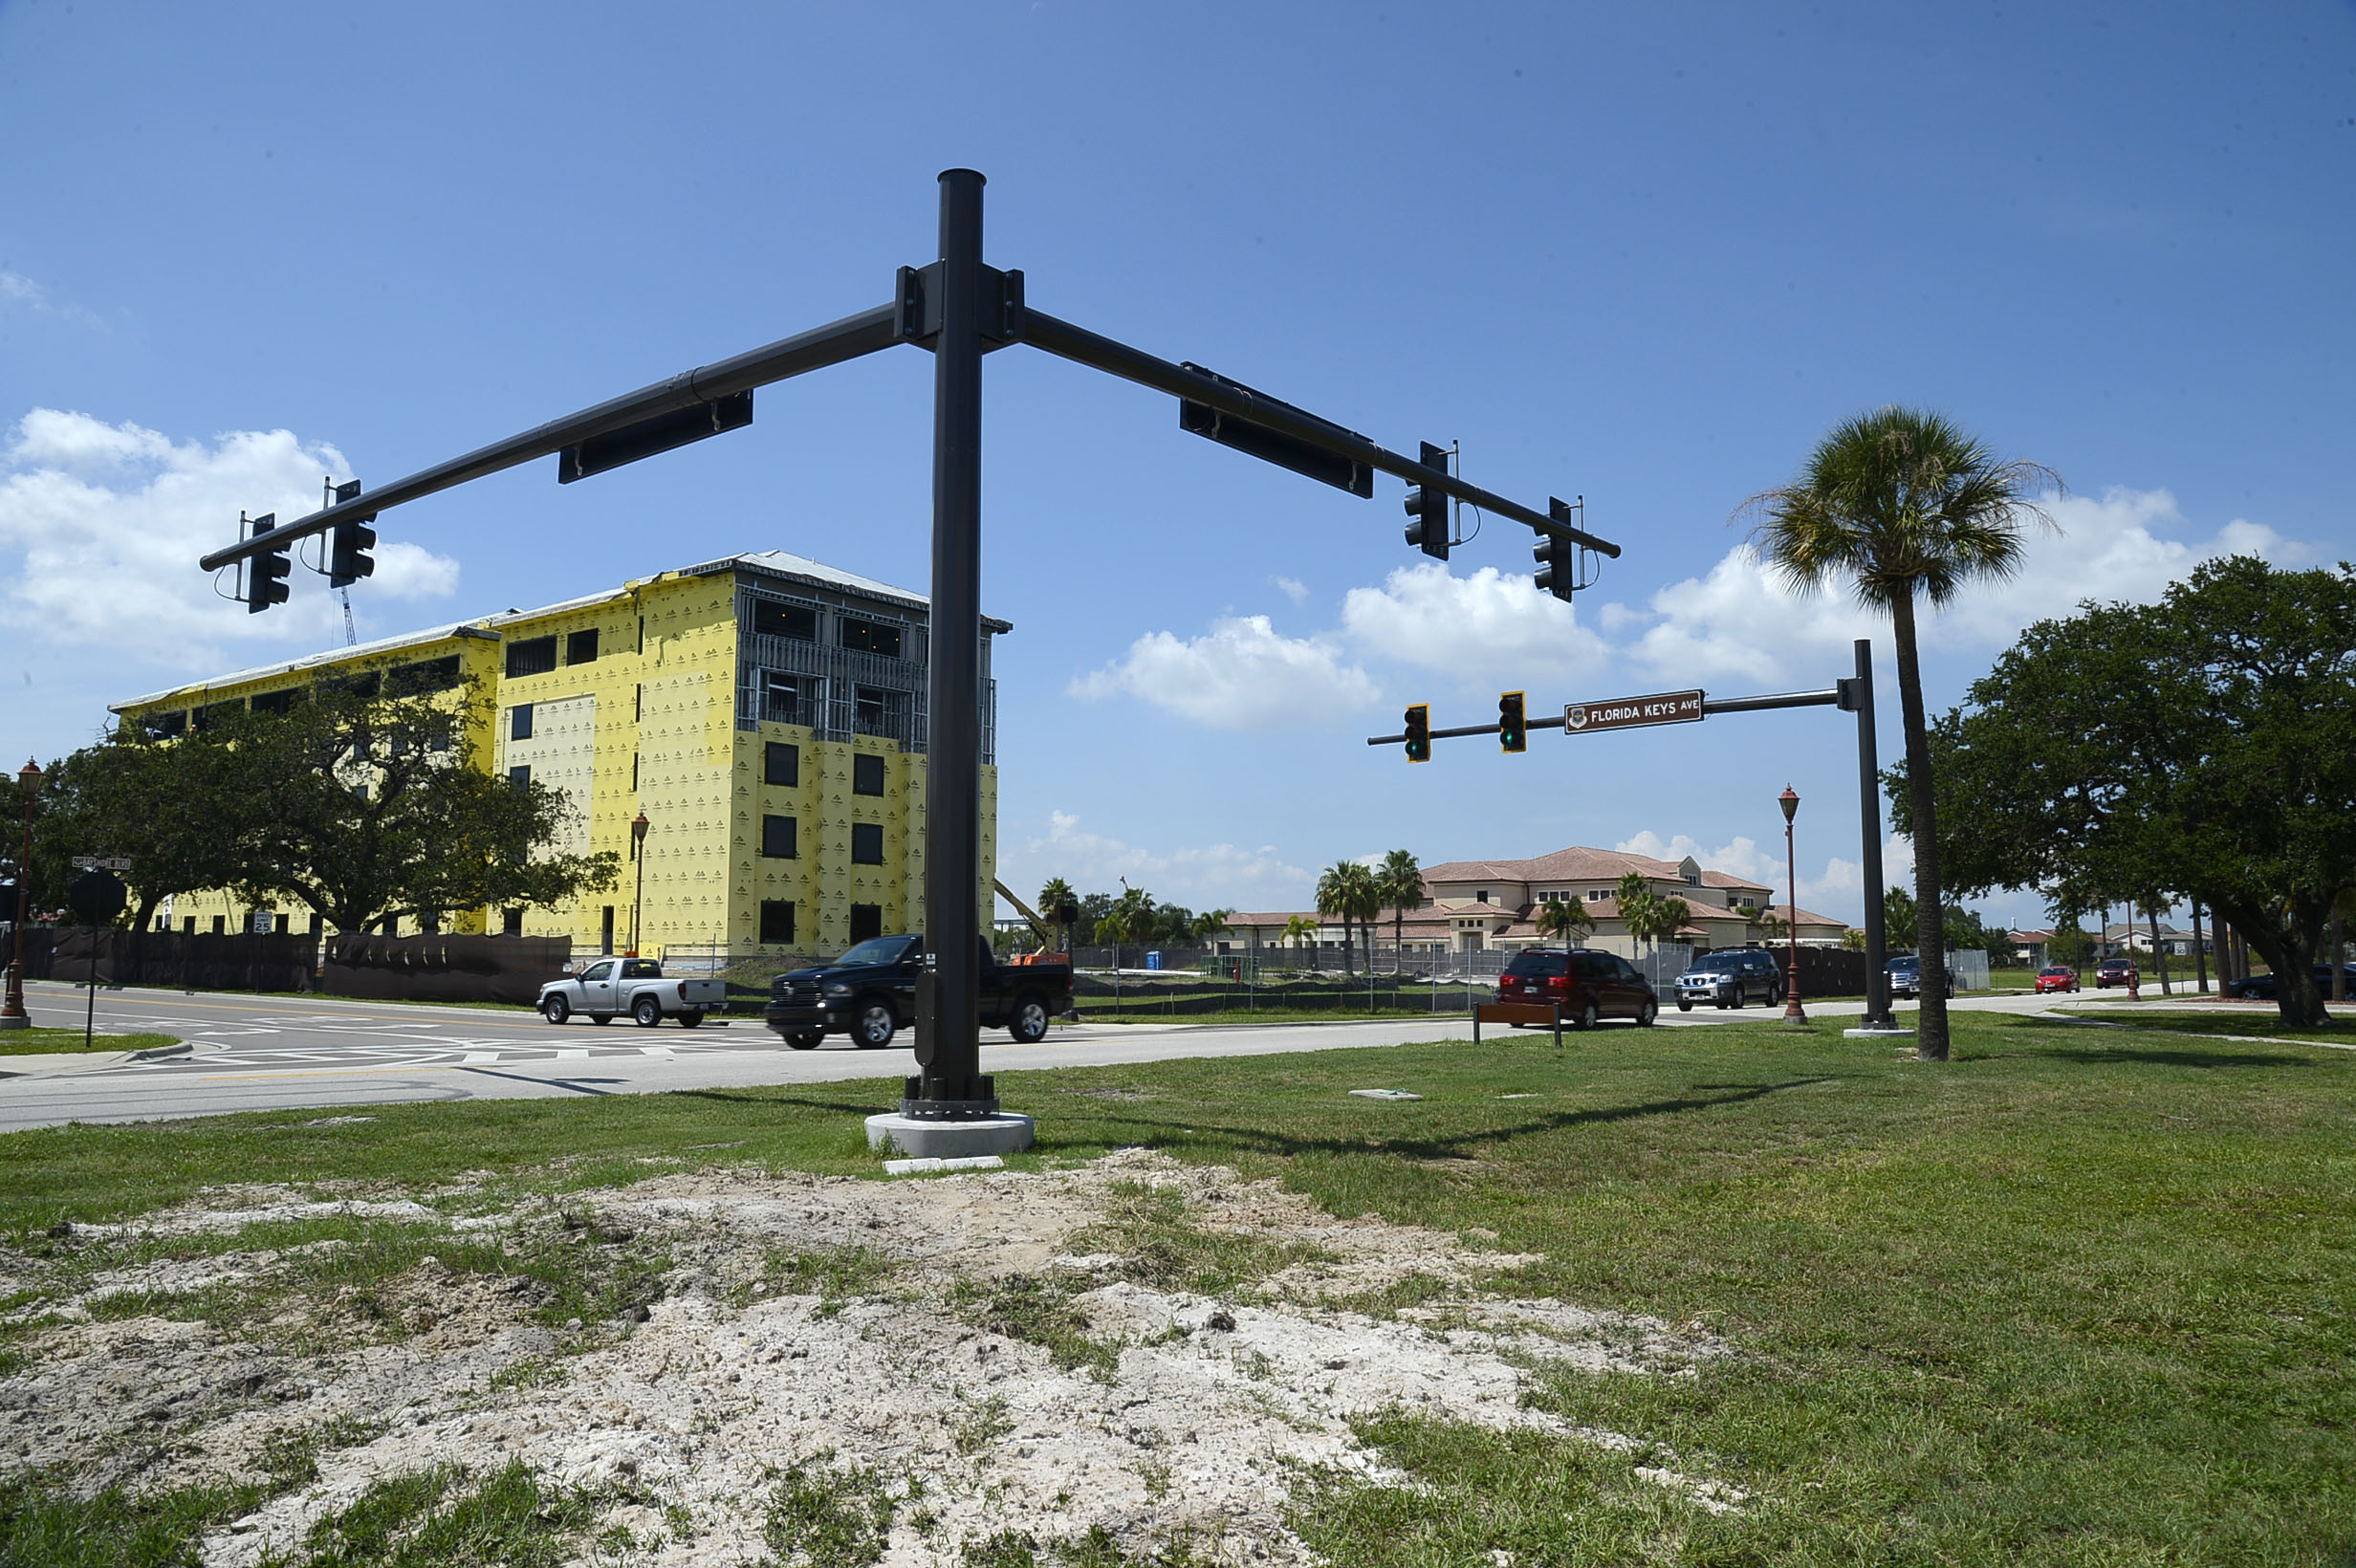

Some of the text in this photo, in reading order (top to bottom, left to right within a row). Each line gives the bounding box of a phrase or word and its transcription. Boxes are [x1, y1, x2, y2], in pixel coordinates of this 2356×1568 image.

[1591, 699, 1699, 723] FLORIDA KEYS AVE
[83, 859, 130, 868] BAYSHORE BLVD
[255, 923, 270, 931] 25
